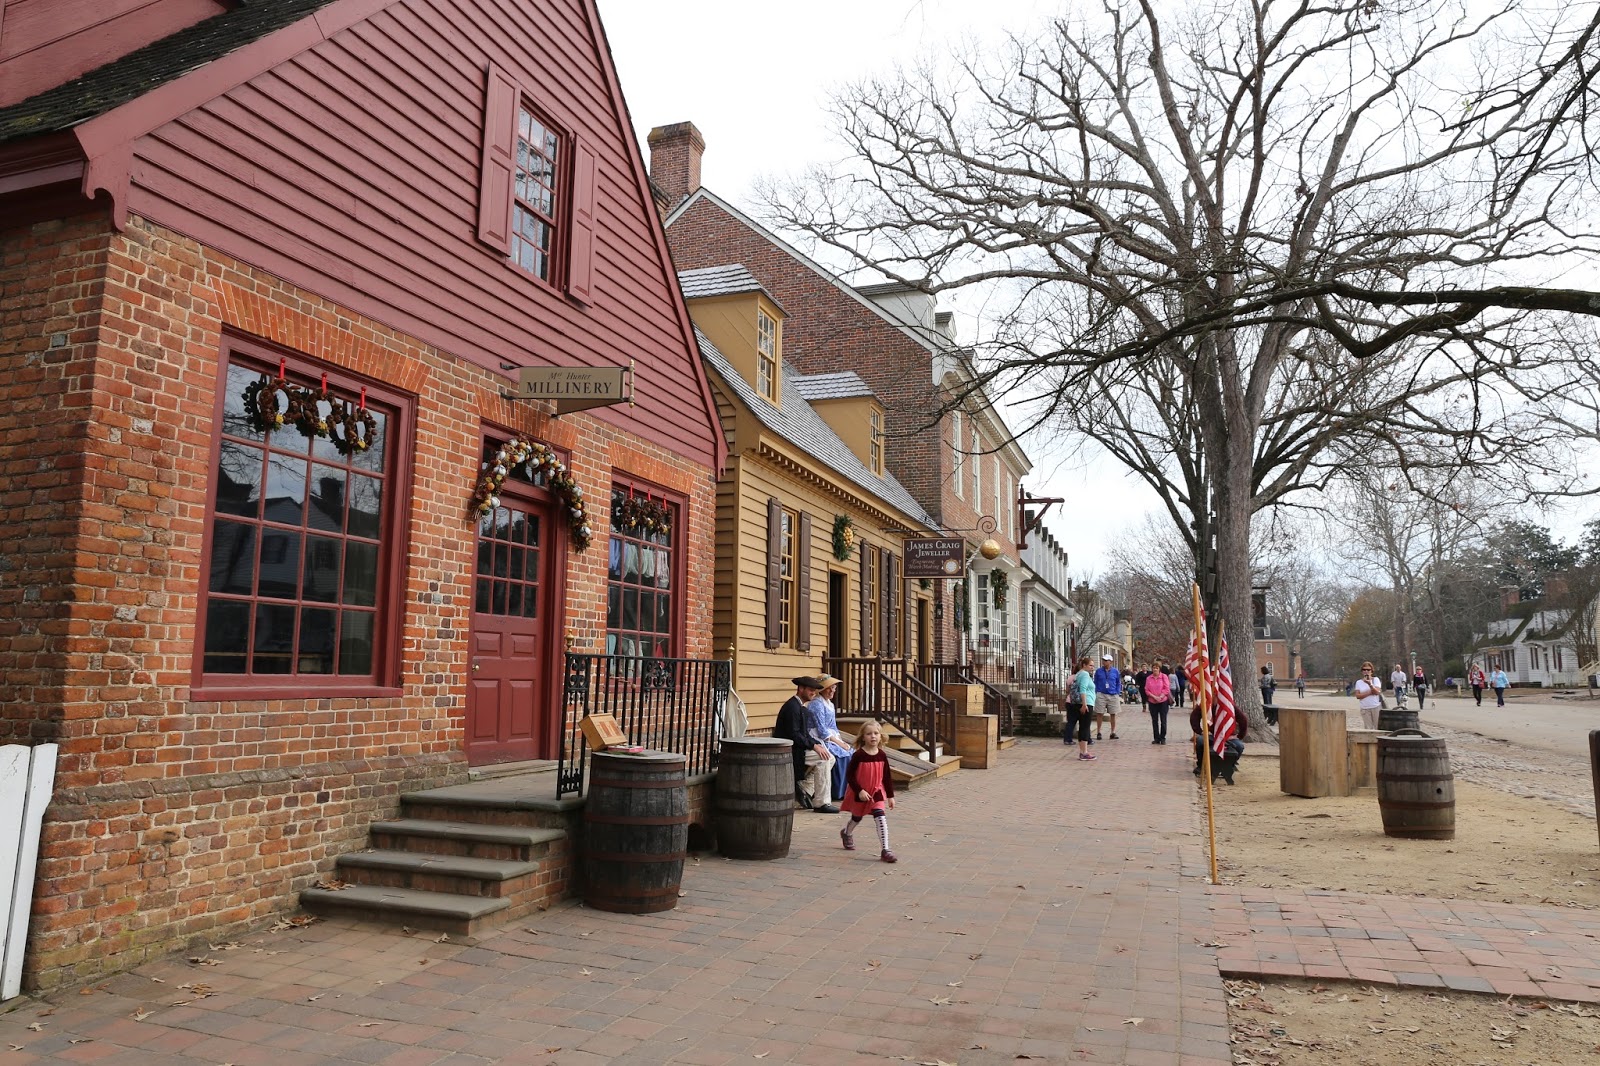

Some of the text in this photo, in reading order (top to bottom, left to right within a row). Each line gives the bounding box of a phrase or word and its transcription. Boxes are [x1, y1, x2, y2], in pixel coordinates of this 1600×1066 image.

[566, 371, 592, 380] Hunter
[526, 382, 612, 394] MILLINERY
[906, 540, 960, 551] JAMES CRAIG
[915, 549, 950, 558] JEWELLER
